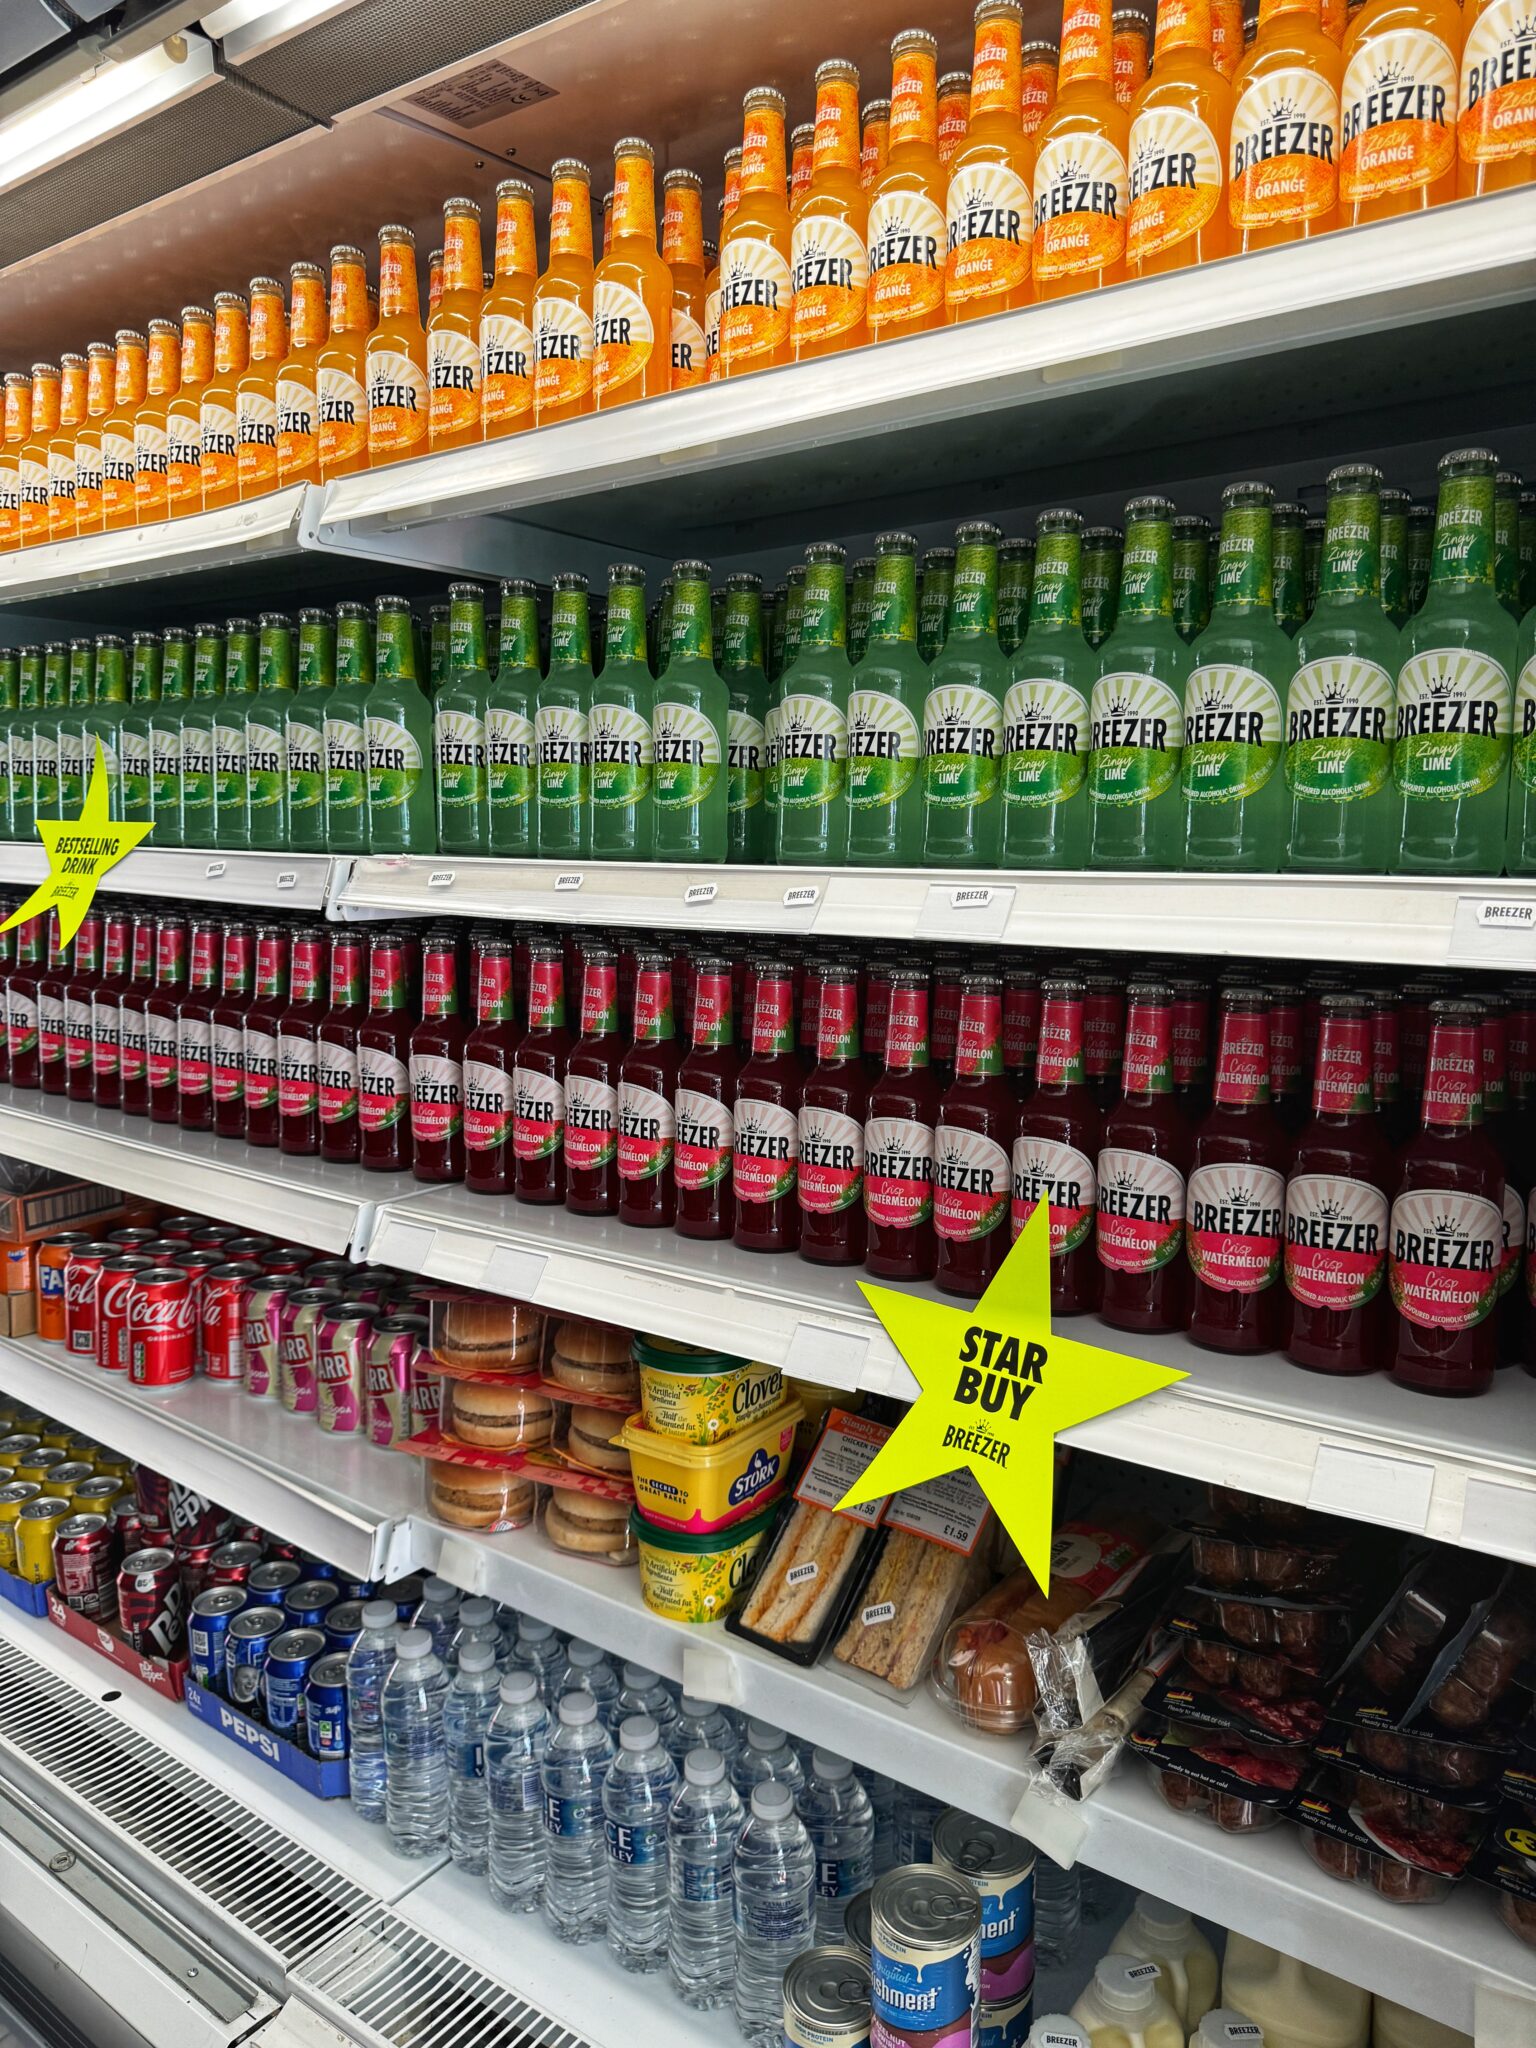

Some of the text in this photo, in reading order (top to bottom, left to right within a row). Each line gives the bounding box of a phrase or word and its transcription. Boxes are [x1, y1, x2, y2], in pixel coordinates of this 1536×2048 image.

[1469, 44, 1536, 112] BREE
[1342, 85, 1446, 150] BREEZER
[1493, 107, 1536, 129] ORAN
[1235, 122, 1333, 181] BREEZER
[1361, 147, 1413, 170] ORANGE
[1256, 179, 1305, 199] ORANGE
[1047, 234, 1089, 254] ORANGE
[870, 236, 939, 276] REEZER
[792, 258, 855, 295] REEZER
[955, 259, 992, 279] ORANGE
[721, 279, 780, 313] REEZER
[875, 283, 911, 301] ORANGE
[795, 305, 827, 321] ORANGE
[595, 318, 634, 345] EZER
[534, 336, 584, 364] EEZER
[430, 366, 475, 393] EEZER
[318, 401, 355, 425] EEZER
[1438, 509, 1482, 528] BREEZER
[1327, 522, 1370, 543] BREEZER
[1442, 546, 1468, 560] LIME
[1332, 559, 1357, 572] LIME
[1220, 572, 1241, 584] LIME
[1289, 706, 1386, 746] BREEZER
[1397, 700, 1498, 740] BREEZER
[1091, 719, 1167, 752] REEZER
[780, 734, 837, 763] REEZER
[1311, 745, 1354, 763] Zingy
[1416, 741, 1461, 760] Zingy
[370, 747, 405, 772] EZER
[1318, 759, 1345, 774] LIME
[1423, 757, 1451, 771] LIME
[938, 773, 959, 784] LIME
[1018, 771, 1040, 782] LIME
[1104, 769, 1126, 780] LIME
[1198, 764, 1220, 777] LIME
[787, 776, 804, 786] LIME
[1322, 785, 1352, 796] ALCOHOLIC
[1353, 781, 1370, 792] DRINK
[1427, 778, 1480, 794] ALCOHOLIC DRINK
[56, 836, 119, 855] BESTSELLING
[62, 857, 99, 875] DRINK
[431, 873, 453, 883] BREEZER
[558, 876, 581, 887] BREEZER
[51, 885, 79, 900] BREEZER
[687, 886, 714, 899] BREEZER
[787, 888, 816, 901] BREEZER
[956, 889, 989, 903] BREEZER
[1485, 906, 1532, 920] BREEZER
[1430, 1056, 1475, 1073] BREEZER
[515, 1101, 554, 1123] EEZER
[676, 1122, 720, 1150] EEZER
[734, 1133, 790, 1162] REEZER
[799, 1142, 854, 1171] REEZER
[865, 1152, 933, 1183] BREEZER
[935, 1164, 994, 1197] REEZER
[869, 1191, 921, 1207] WATERMELON
[1014, 1173, 1081, 1210] REEZER
[1098, 1186, 1171, 1226] REEZER
[1194, 1201, 1282, 1238] BREEZER
[1287, 1216, 1378, 1256] BREEZER
[1202, 1249, 1270, 1268] WATERMELON
[1395, 1229, 1494, 1273] BREEZER
[1257, 1274, 1270, 1284] DRINK
[1294, 1264, 1365, 1285] WATERMELON
[1404, 1283, 1479, 1304] WATERMELON
[128, 1292, 180, 1324] Coca
[1431, 1314, 1462, 1324] ALCOHOLIC
[1464, 1310, 1480, 1321] DRINK
[285, 1336, 310, 1363] ARR
[958, 1326, 1048, 1384] STAR
[319, 1355, 350, 1381] ARR
[652, 1386, 681, 1399] Artificial
[733, 1372, 783, 1414] Clover
[953, 1366, 1035, 1421] BUY
[942, 1424, 1011, 1468] BREEZER
[651, 1482, 676, 1494] SECRET
[735, 1460, 776, 1497] STORK
[639, 1485, 687, 1504] GREAT BAKES
[944, 1524, 968, 1541] £1.59
[790, 1565, 815, 1580] BREEZER
[866, 1605, 891, 1620] BREEZER
[221, 1707, 280, 1761] PEPSI
[1302, 1813, 1318, 1826] Ready
[606, 1821, 632, 1851] CE
[1128, 1965, 1158, 1978] BREEZER
[871, 1972, 938, 2011] ishment
[1229, 2027, 1261, 2035] BREEZER
[1046, 2036, 1077, 2047] BREEZER
